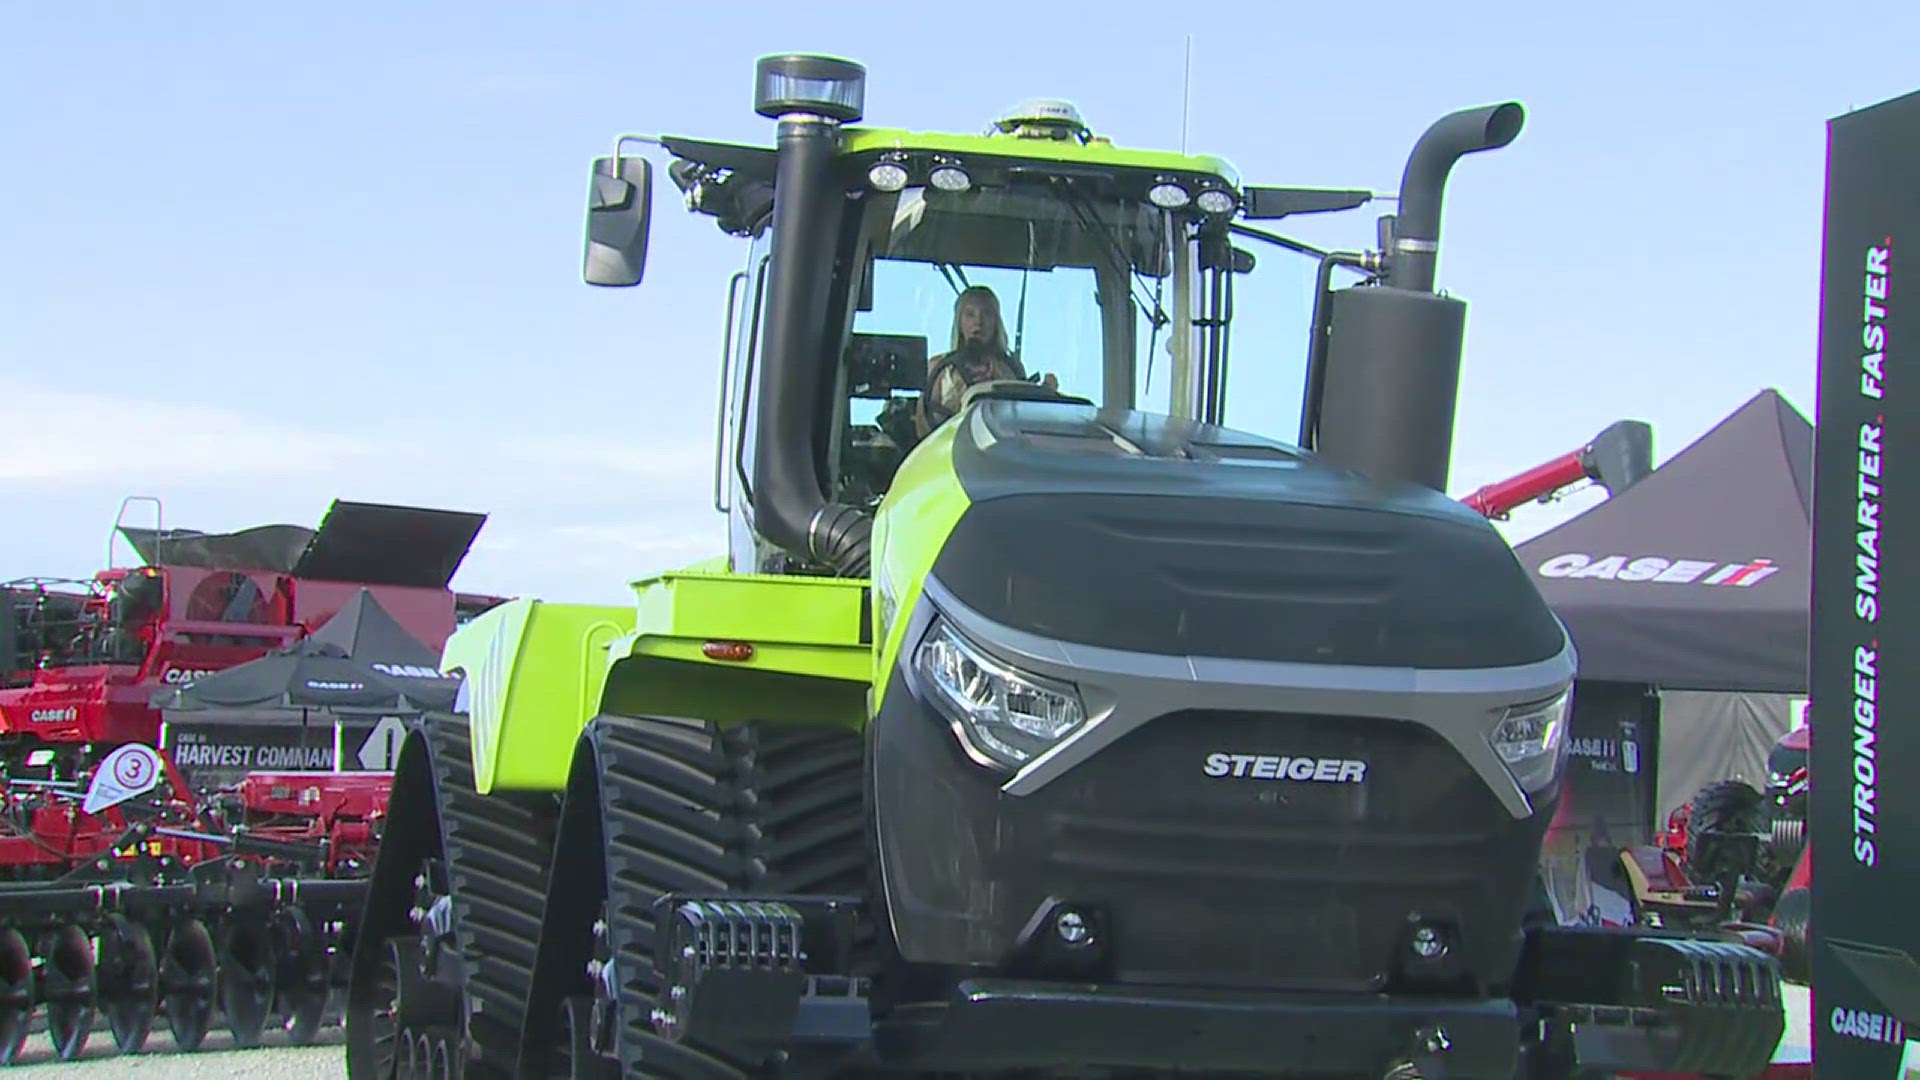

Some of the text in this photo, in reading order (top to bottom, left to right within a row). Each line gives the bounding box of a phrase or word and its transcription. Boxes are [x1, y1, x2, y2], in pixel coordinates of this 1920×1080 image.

[1853, 236, 1892, 867] STRONGER. SMARTER. FASTER.
[1538, 553, 1717, 583] CASE
[124, 758, 143, 779] 3
[175, 744, 341, 768] HARVEST COMMAN
[1203, 753, 1367, 783] STEIGER
[1830, 1006, 1884, 1041] CASE
